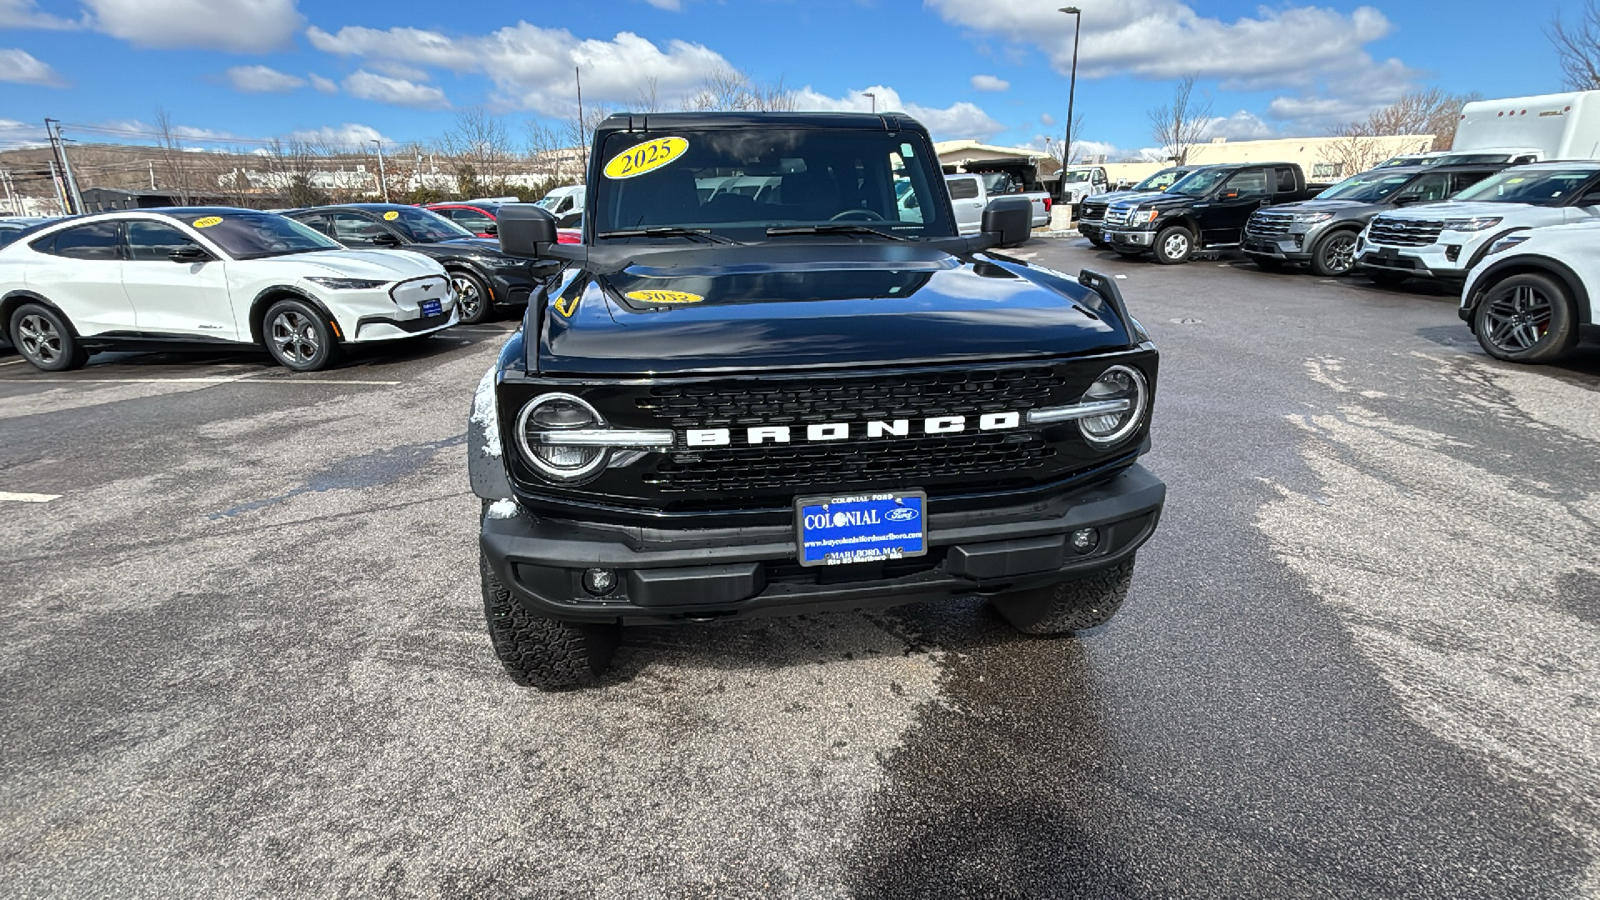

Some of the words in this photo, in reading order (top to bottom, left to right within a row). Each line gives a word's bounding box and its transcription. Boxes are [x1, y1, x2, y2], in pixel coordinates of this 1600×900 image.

[621, 140, 671, 174] 2025
[686, 411, 1020, 446] BRONCO
[831, 496, 869, 504] COLONIAL
[872, 493, 894, 501] FORD
[804, 509, 881, 530] COLONIAL
[889, 508, 914, 520] Ford
